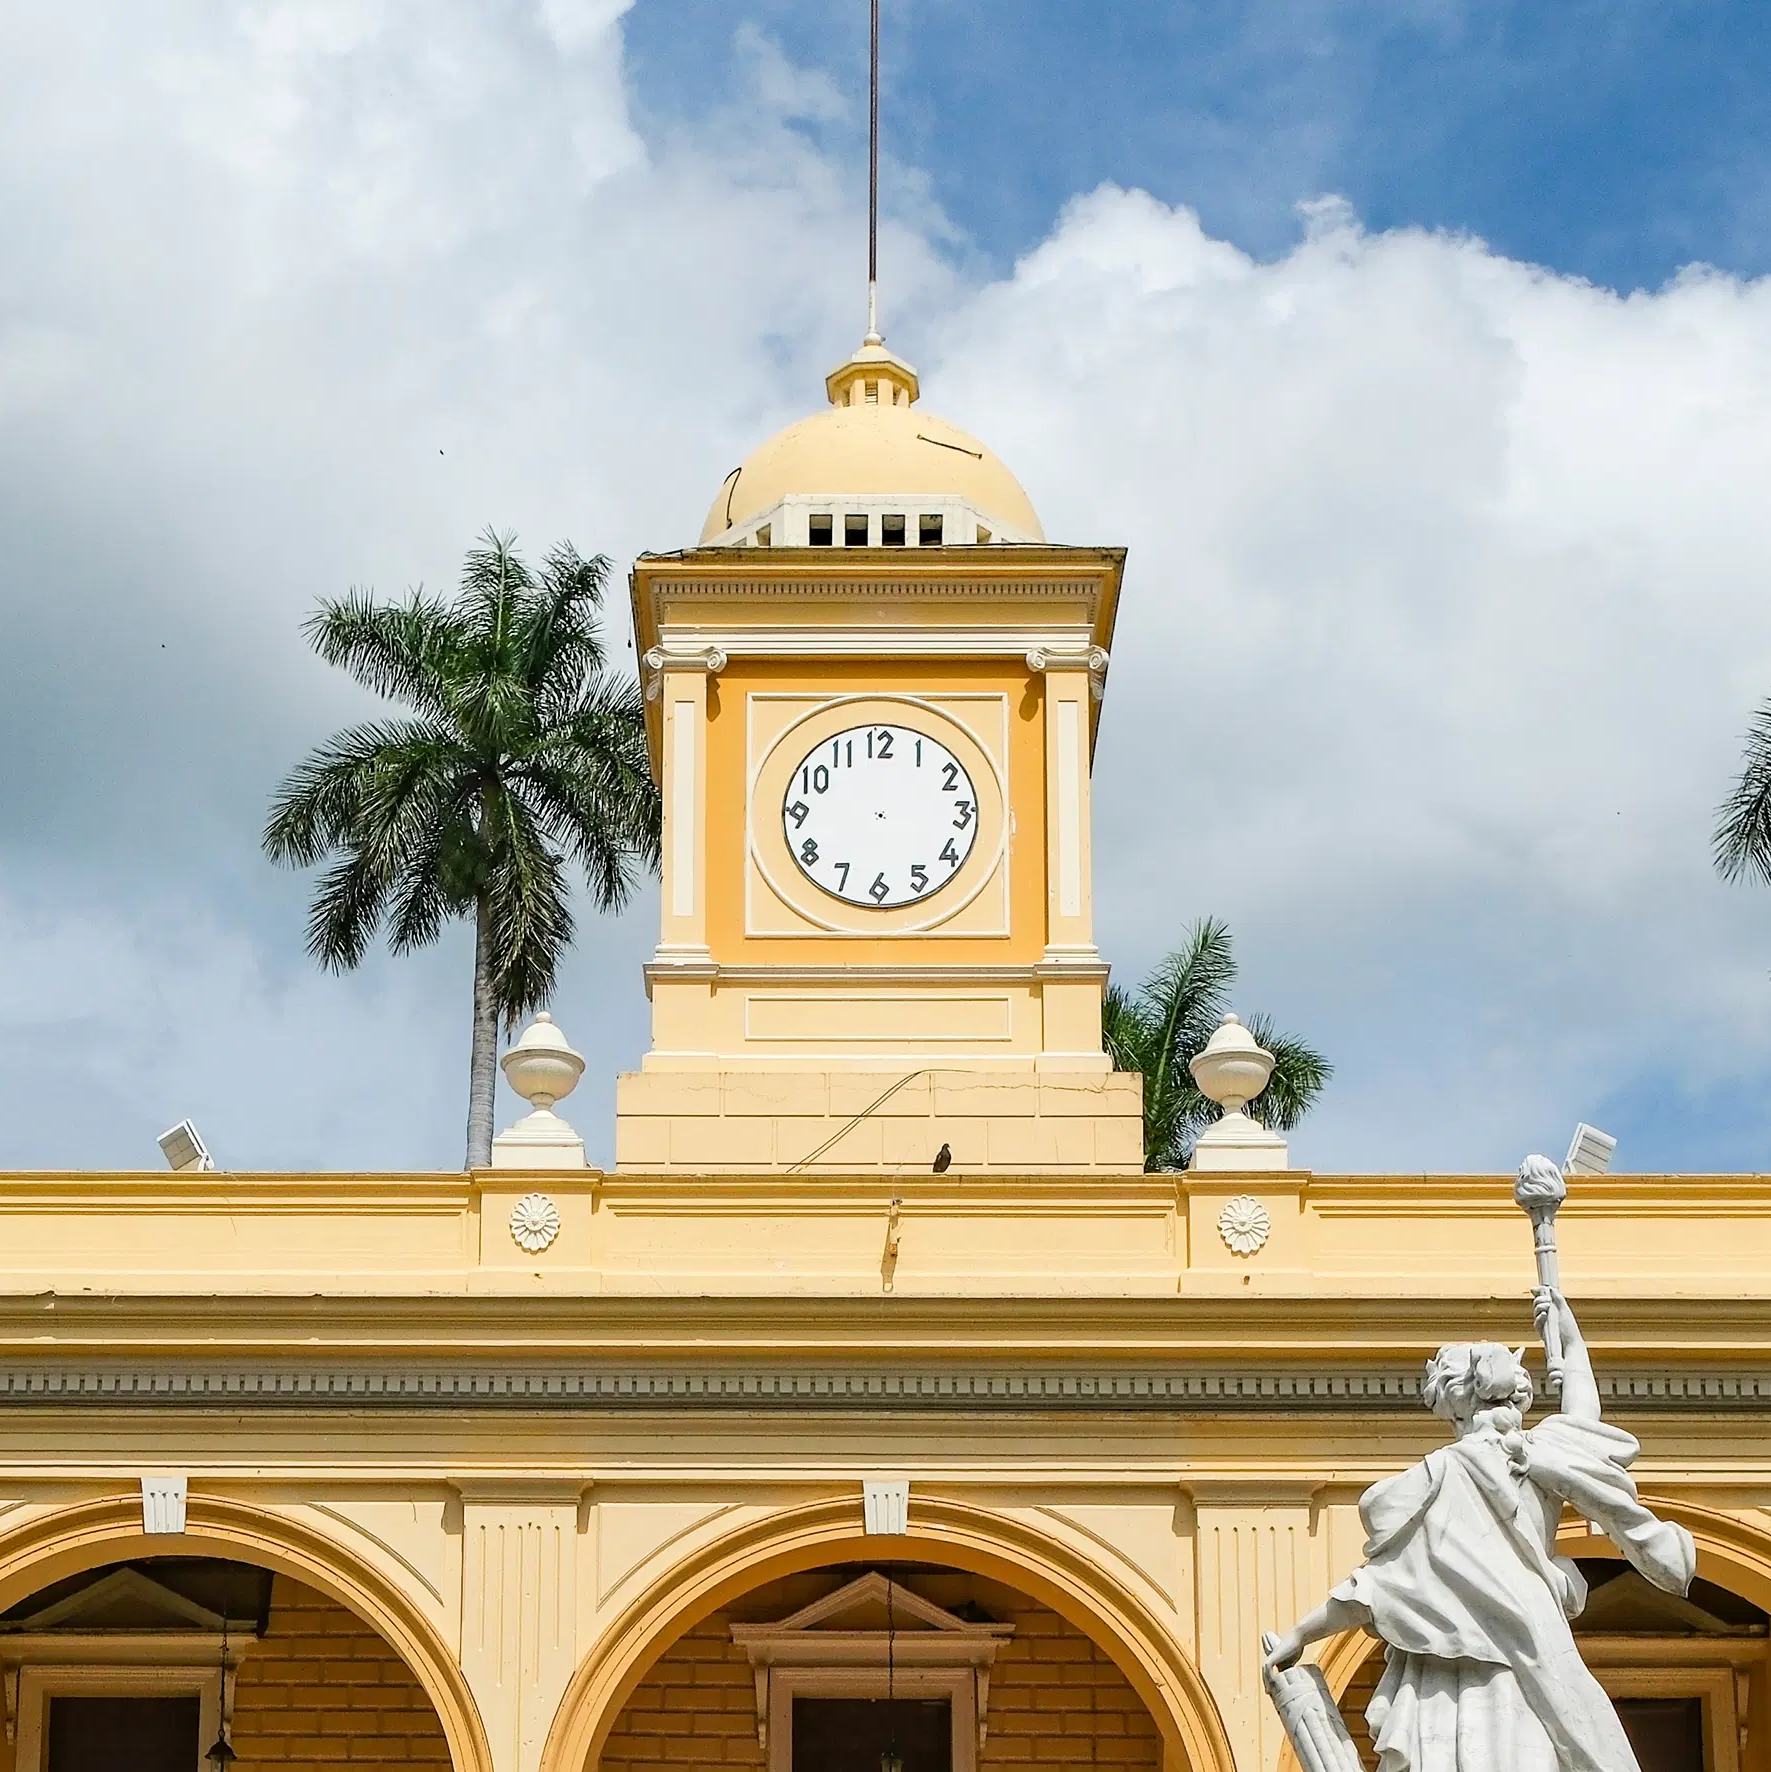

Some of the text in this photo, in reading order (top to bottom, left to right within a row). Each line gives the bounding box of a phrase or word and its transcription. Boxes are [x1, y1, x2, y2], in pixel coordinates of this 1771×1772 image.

[832, 739, 853, 768] 11
[866, 730, 894, 759] 12
[915, 739, 922, 768] 1
[802, 764, 829, 795] 10
[941, 762, 958, 791] 2
[788, 800, 810, 829] 9
[952, 800, 972, 830] 3
[800, 837, 819, 867] 8
[938, 837, 959, 868] 4
[834, 862, 850, 892] 7
[868, 871, 890, 904] 6
[910, 864, 929, 893] 5
